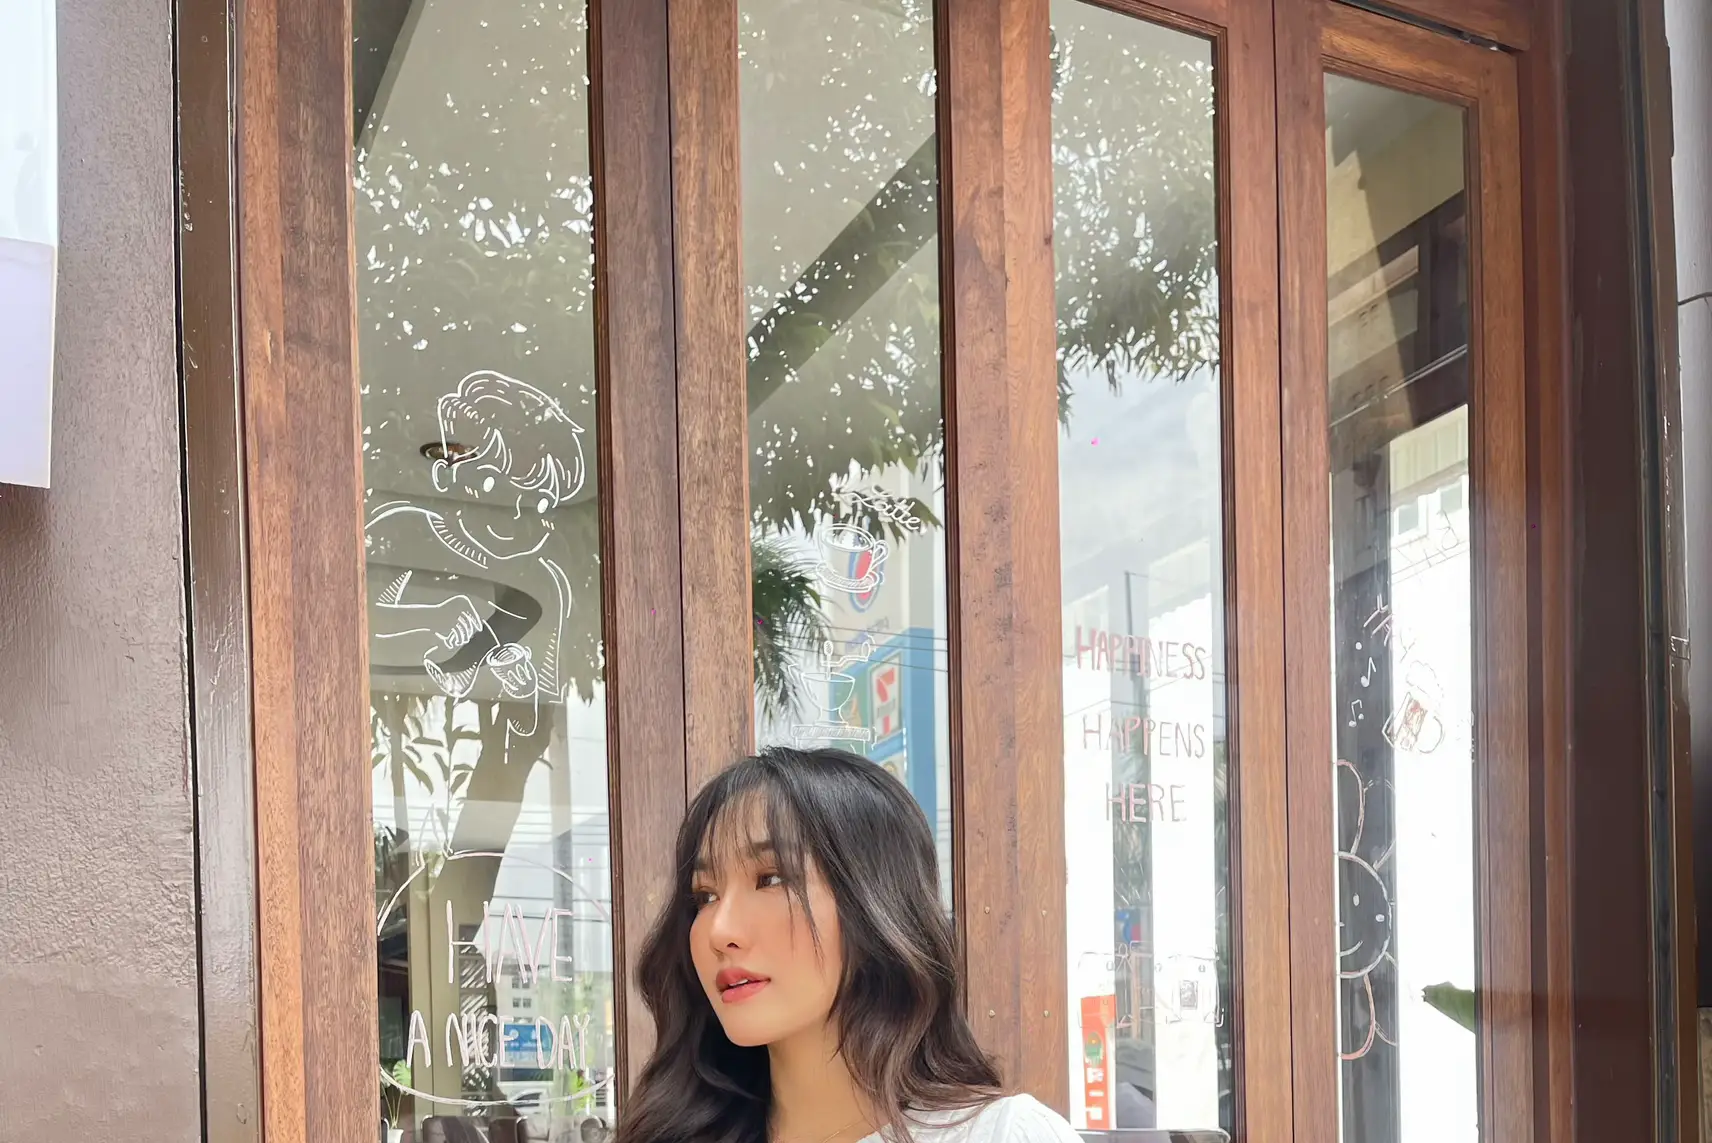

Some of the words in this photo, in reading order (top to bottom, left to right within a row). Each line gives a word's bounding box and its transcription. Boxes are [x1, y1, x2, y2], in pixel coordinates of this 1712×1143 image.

[846, 484, 921, 530] Latte
[1076, 625, 1206, 680] HAPPINESS
[1083, 713, 1205, 758] HAPPENS
[1106, 783, 1187, 823] HERE
[446, 900, 572, 983] HAVE
[406, 1010, 431, 1067] A
[446, 1012, 515, 1067] NICE
[535, 1015, 590, 1070] DAY
